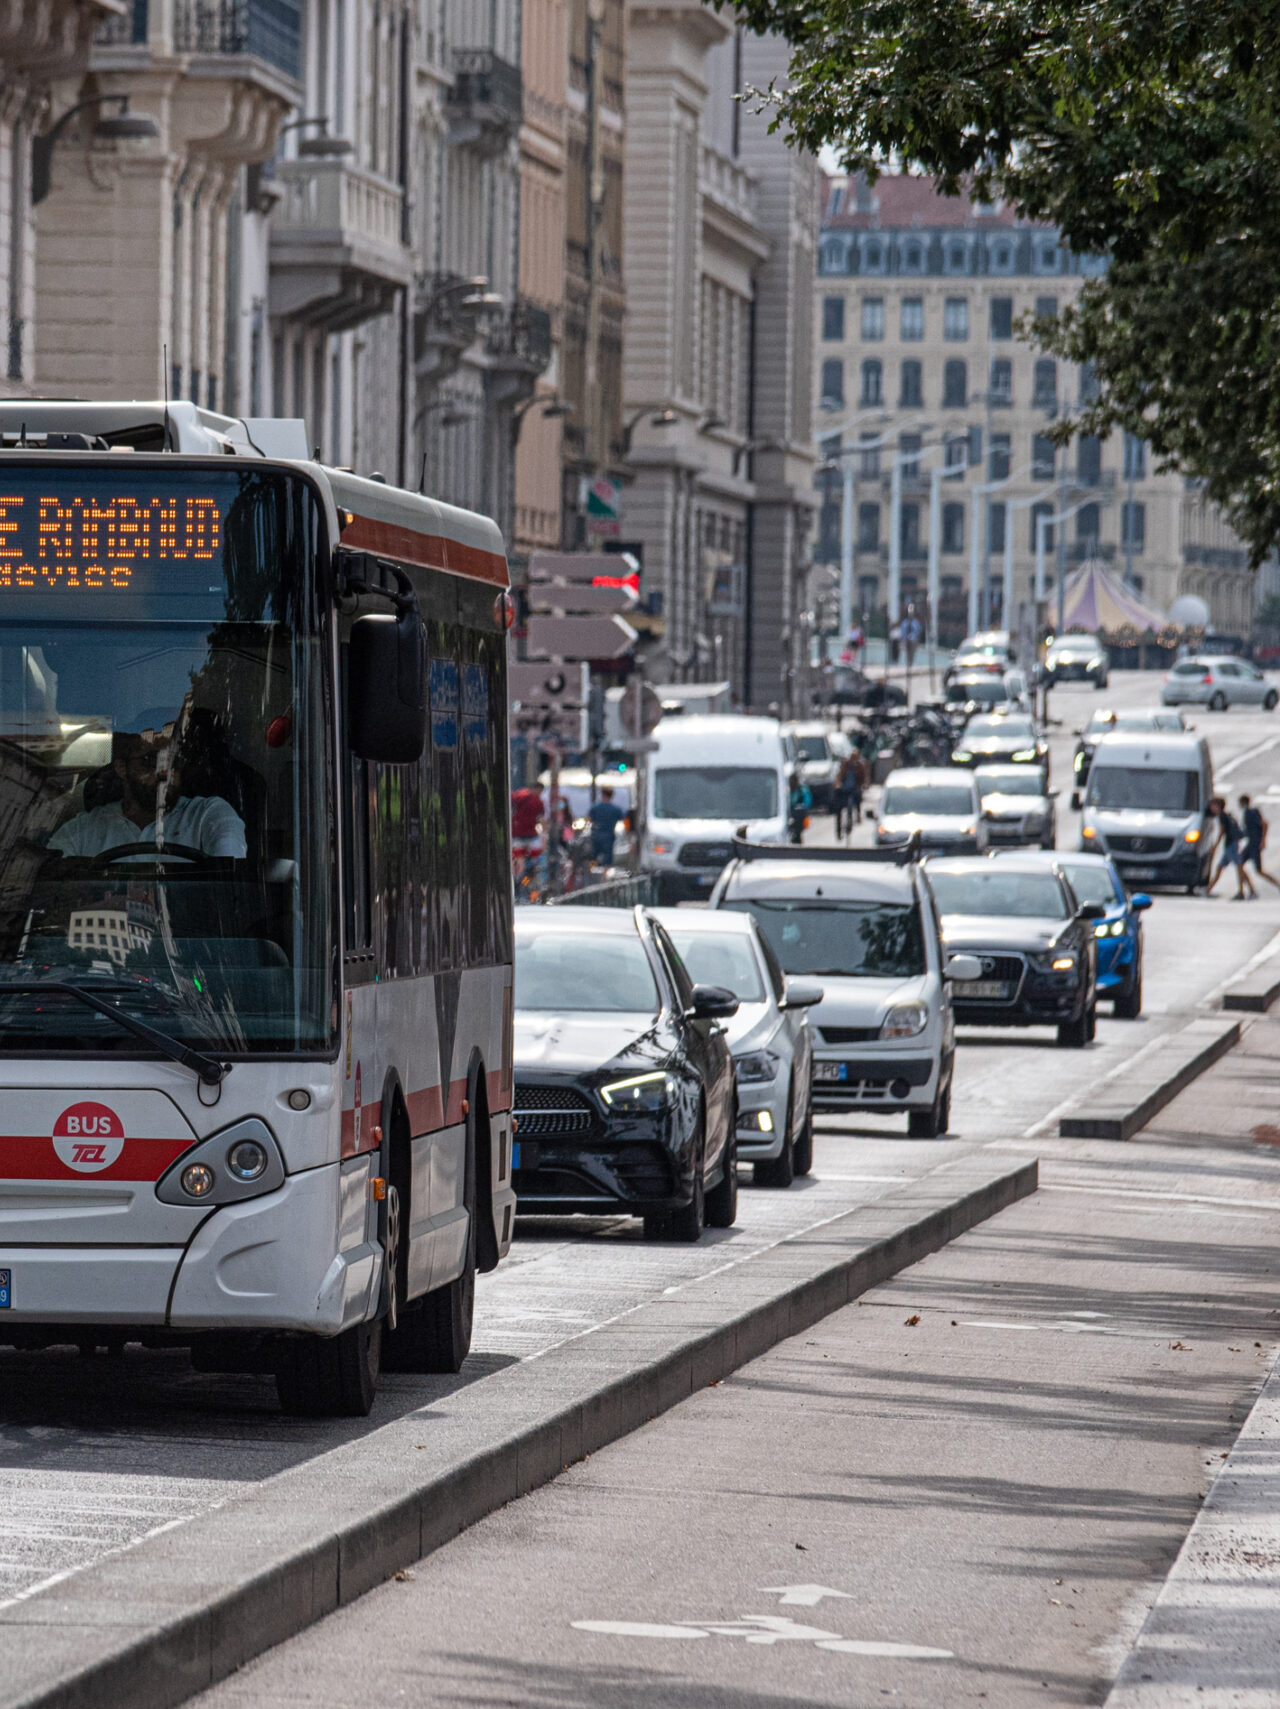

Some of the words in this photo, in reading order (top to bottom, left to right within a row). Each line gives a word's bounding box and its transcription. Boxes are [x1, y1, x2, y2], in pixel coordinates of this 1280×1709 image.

[39, 498, 220, 560] RAMBAUD
[67, 1116, 111, 1134] BUS
[72, 1143, 107, 1163] TCL
